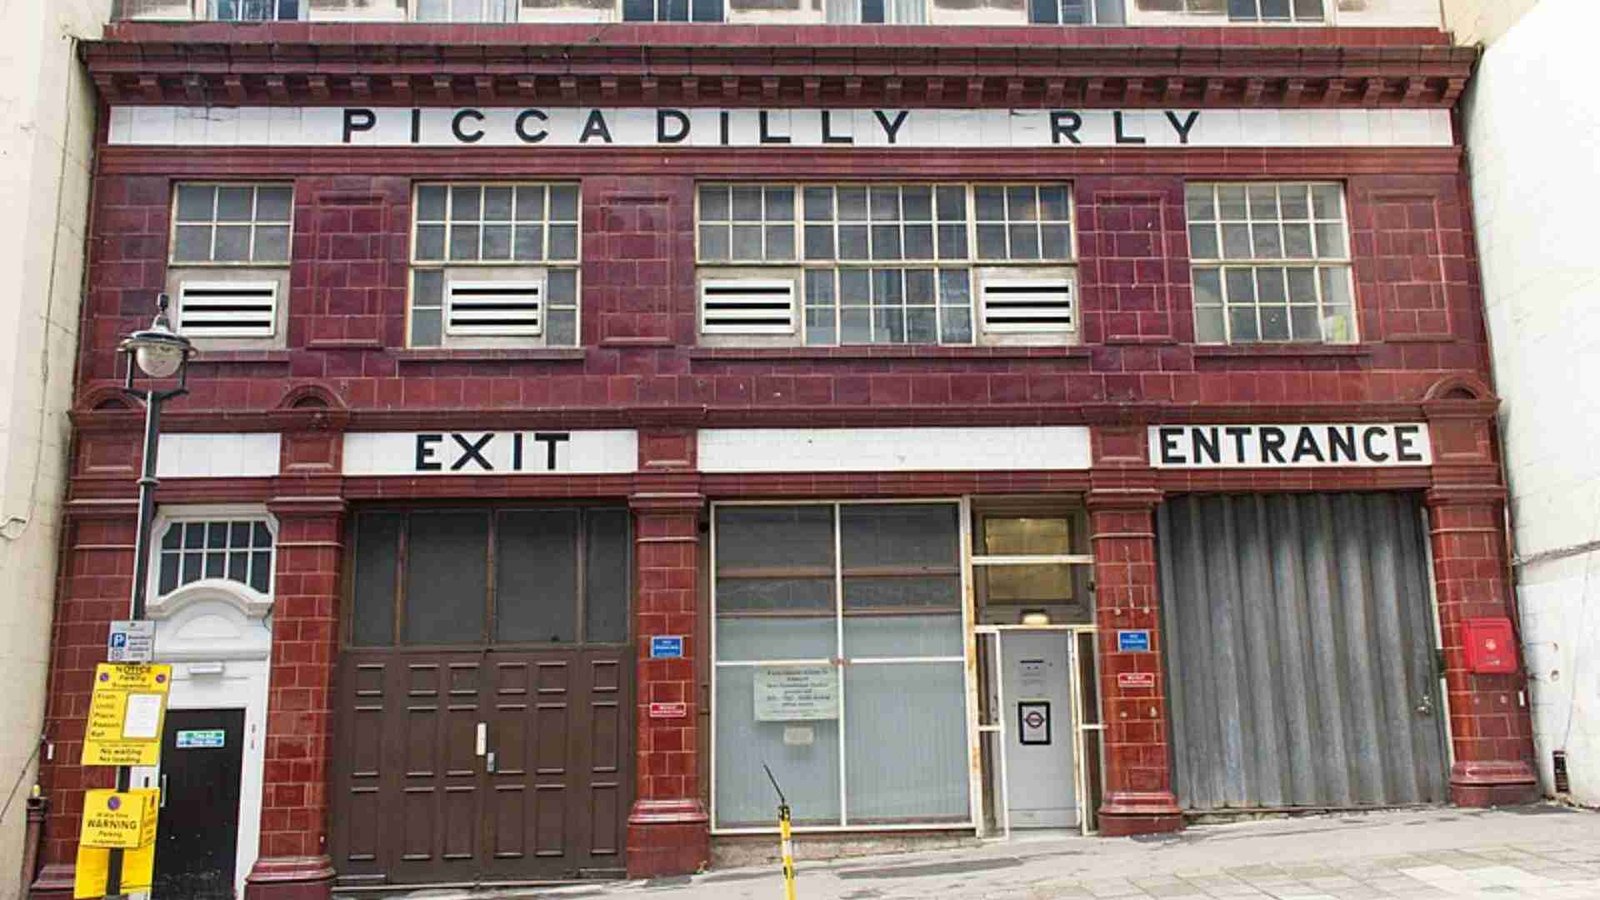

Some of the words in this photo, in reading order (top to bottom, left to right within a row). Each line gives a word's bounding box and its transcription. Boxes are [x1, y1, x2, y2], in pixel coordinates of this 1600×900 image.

[342, 108, 909, 144] PICCADILLY
[1049, 110, 1199, 144] RLY
[415, 432, 570, 471] EXIT
[1159, 425, 1422, 464] ENTRANCE
[115, 665, 152, 674] NOTICE
[87, 819, 137, 829] WARNING
